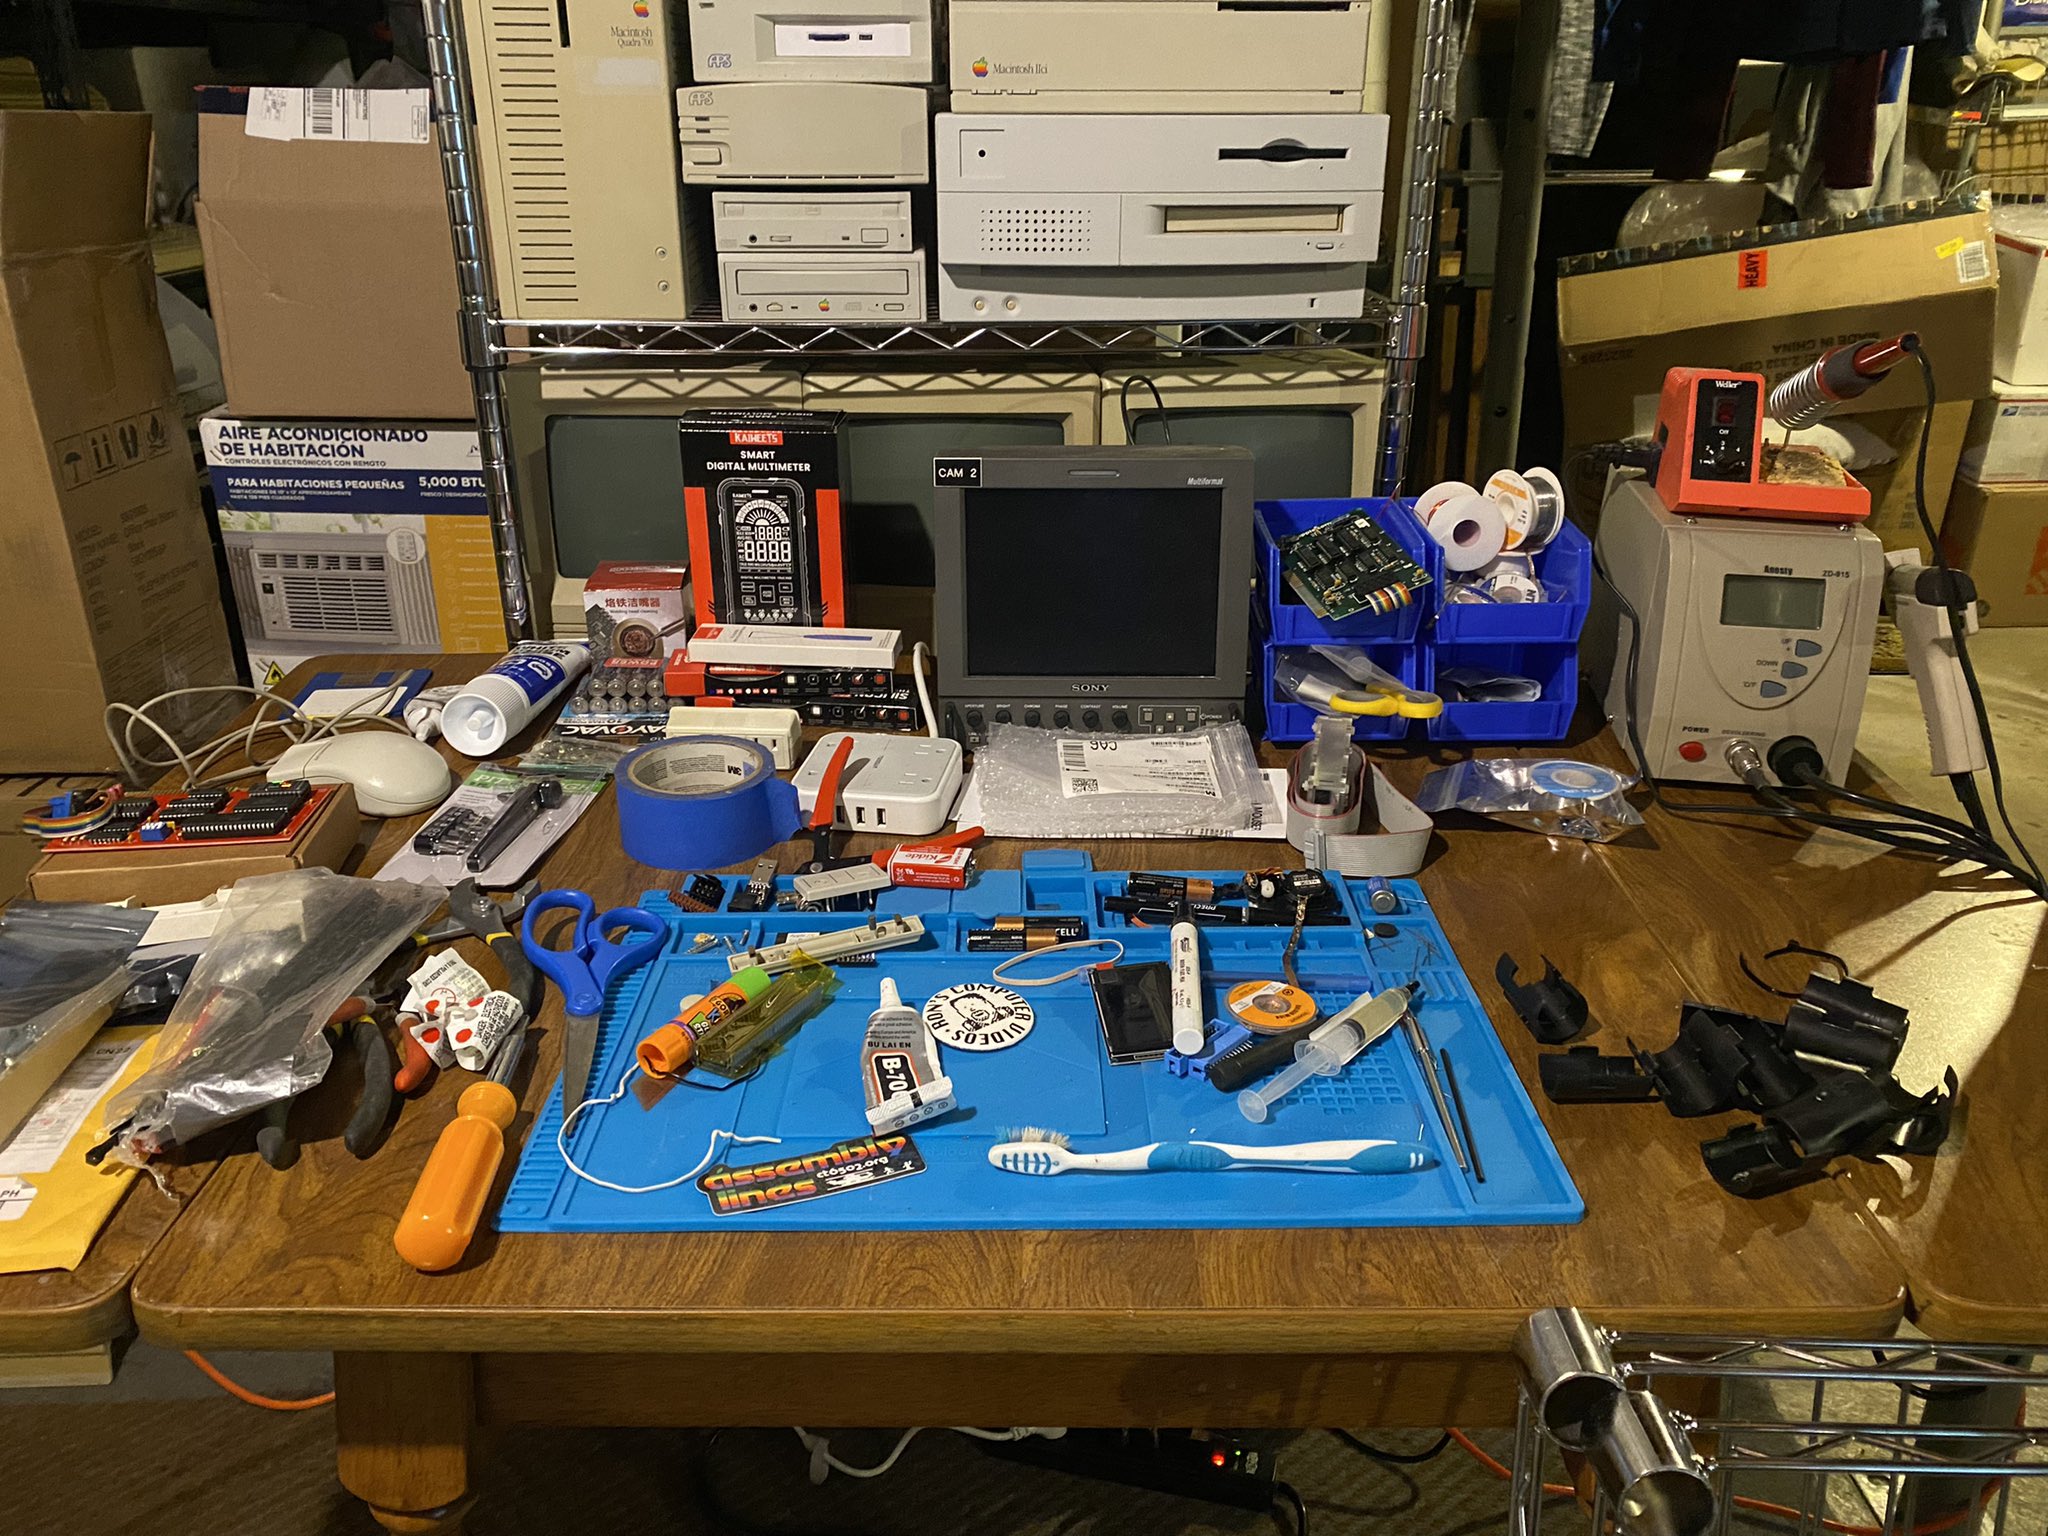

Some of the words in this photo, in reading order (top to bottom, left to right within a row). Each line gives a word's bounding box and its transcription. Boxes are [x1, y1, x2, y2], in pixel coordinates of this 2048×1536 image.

[611, 26, 652, 38] Macintosh
[617, 38, 641, 48] Quadra
[642, 38, 653, 47] 700
[993, 63, 1033, 74] Macintosh
[1746, 252, 1759, 288] HEAVY
[1772, 338, 1816, 354] CHINA
[1715, 380, 1737, 388] Weller
[219, 426, 262, 440] AIRE
[267, 427, 428, 442] ACONDICIONADO
[220, 442, 245, 456] DE
[249, 440, 364, 457] HABITACIÓN
[740, 451, 776, 459] SMART
[706, 462, 745, 471] DIGITAL
[748, 462, 811, 472] MULTIMETER
[938, 468, 964, 478] CAM
[970, 468, 977, 478] 2
[227, 478, 258, 487] PARA
[260, 479, 343, 489] HABITACIONES
[345, 478, 405, 490] PEQUEÑAS
[419, 476, 458, 488] 5,000
[1187, 477, 1224, 486] Multiformat
[1071, 683, 1110, 692] SONY
[905, 853, 938, 861] Kidde
[927, 993, 949, 1030] RON'S
[950, 983, 1031, 1022] COMPUTER
[704, 1135, 907, 1190] assembly
[816, 1156, 889, 1179] ct6502.org
[716, 1179, 817, 1211] lines
